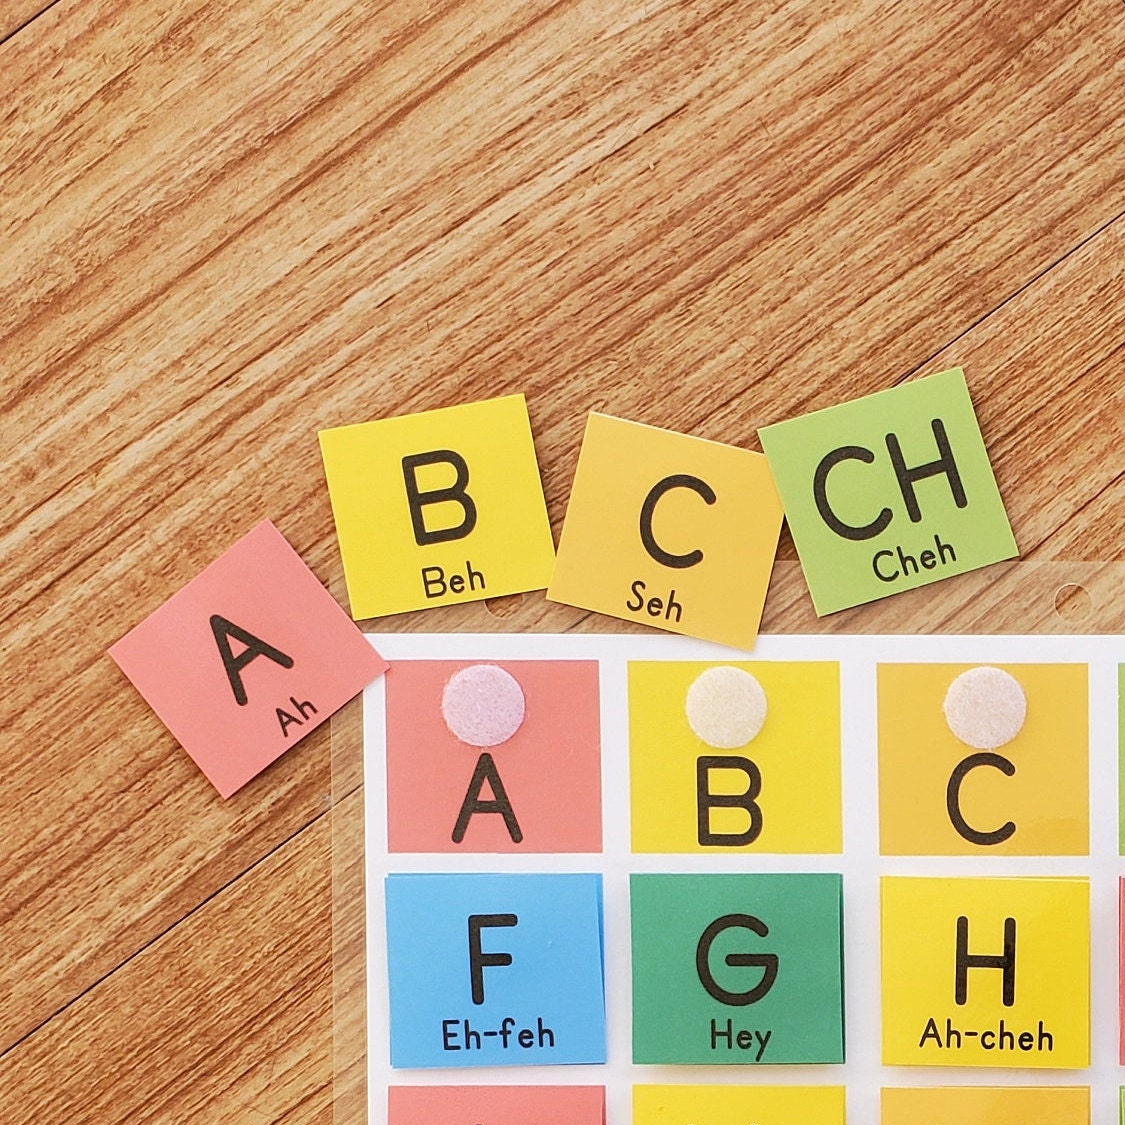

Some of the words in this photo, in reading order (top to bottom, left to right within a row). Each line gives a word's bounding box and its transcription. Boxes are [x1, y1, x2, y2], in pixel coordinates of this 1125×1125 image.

[401, 449, 478, 547] B
[639, 473, 717, 569] C
[813, 418, 969, 541] CH
[421, 560, 487, 599] Beh
[626, 580, 683, 623] Seh
[872, 534, 957, 583] Cheh
[209, 614, 295, 706] A
[275, 696, 319, 738] Ah
[451, 752, 524, 844] A
[696, 755, 763, 847] B
[946, 752, 1016, 846] C
[467, 913, 518, 1006] F
[695, 913, 779, 1007] G
[954, 915, 1016, 1007] H
[442, 1017, 555, 1051] Eh-feh
[710, 1018, 772, 1063] Hey
[919, 1017, 1053, 1052] Ah-cheh
